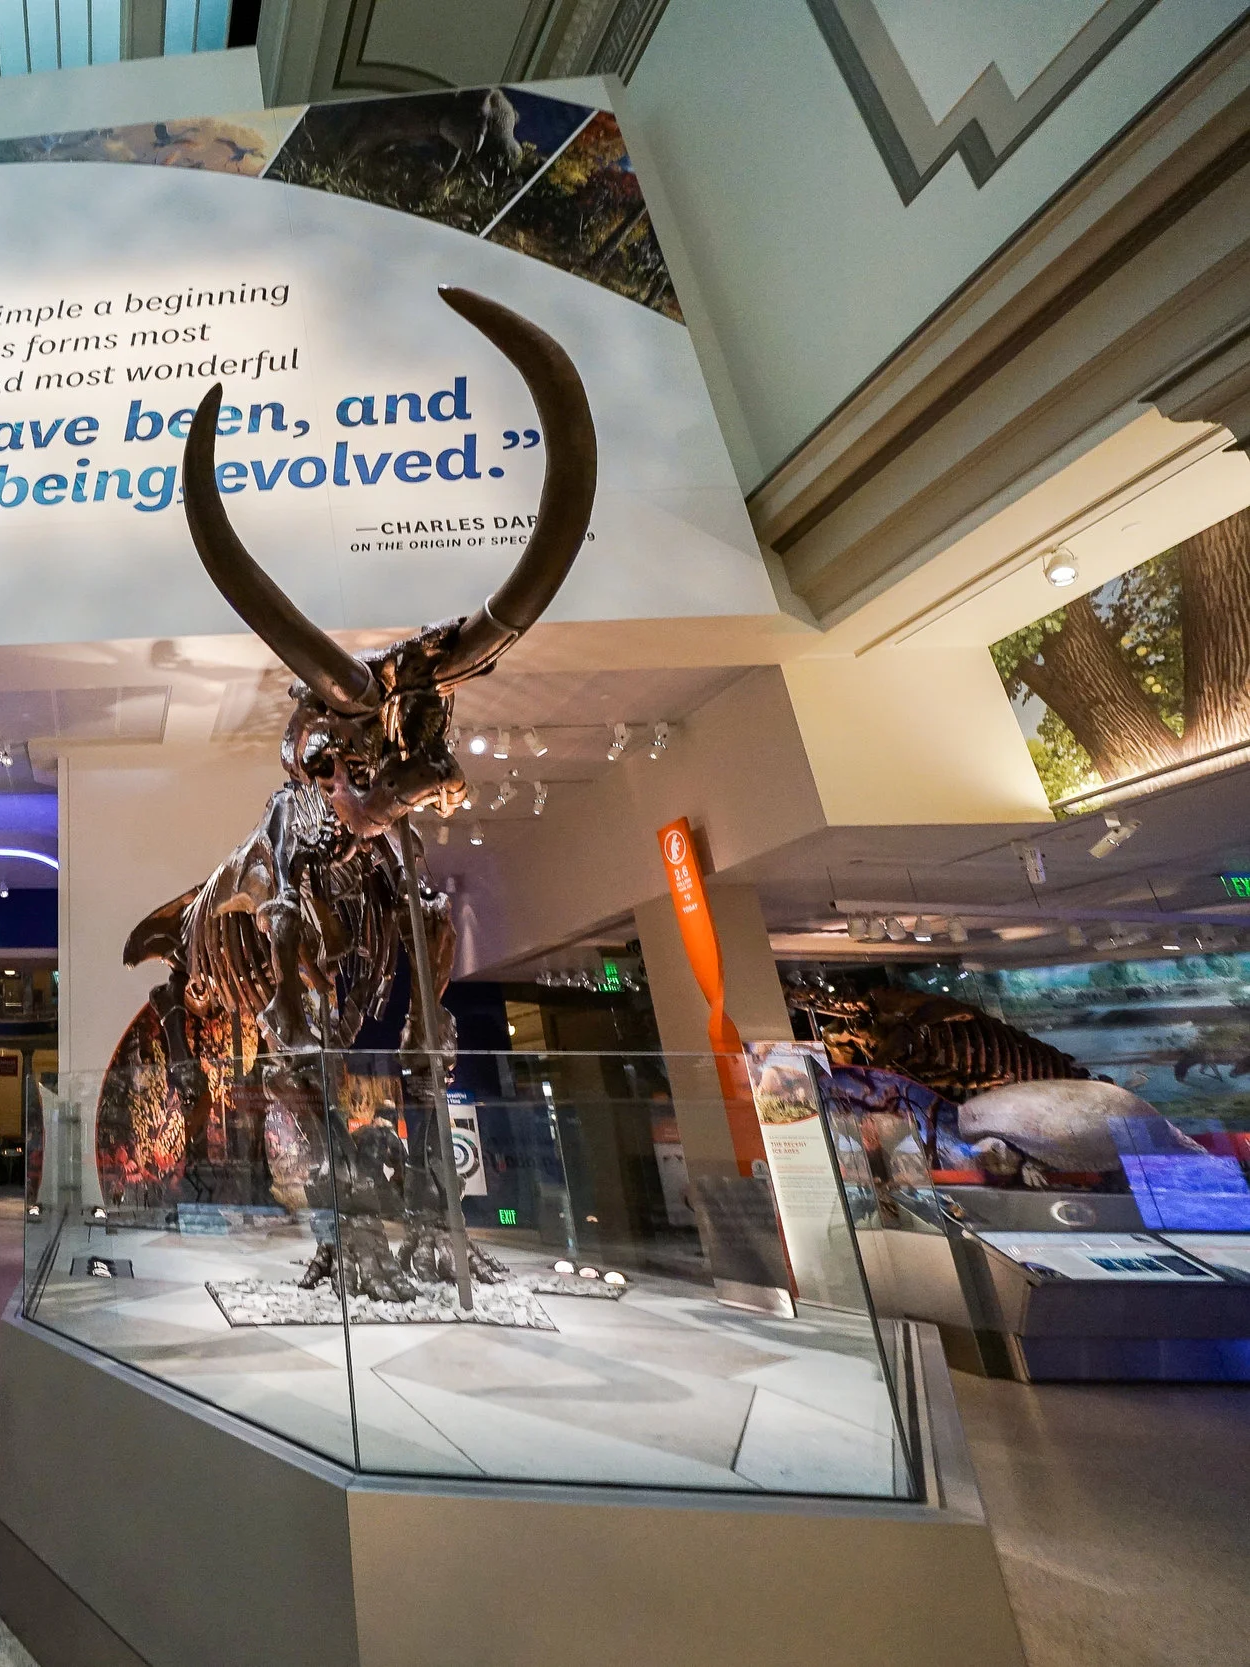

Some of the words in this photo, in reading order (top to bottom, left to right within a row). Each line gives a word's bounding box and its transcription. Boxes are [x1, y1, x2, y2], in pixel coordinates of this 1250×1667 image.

[94, 300, 112, 316] a
[125, 283, 290, 316] beginning
[22, 333, 118, 363] forms
[130, 323, 212, 347] most
[35, 365, 115, 390] most
[126, 347, 299, 382] wonderful
[124, 400, 310, 442] been,
[336, 376, 472, 428] and
[215, 429, 541, 494] evolved.”
[350, 542, 371, 552] ON
[377, 540, 404, 551] THE
[409, 537, 461, 550] ORIGIN
[467, 537, 486, 547] OF
[499, 1209, 516, 1224] EXIT
